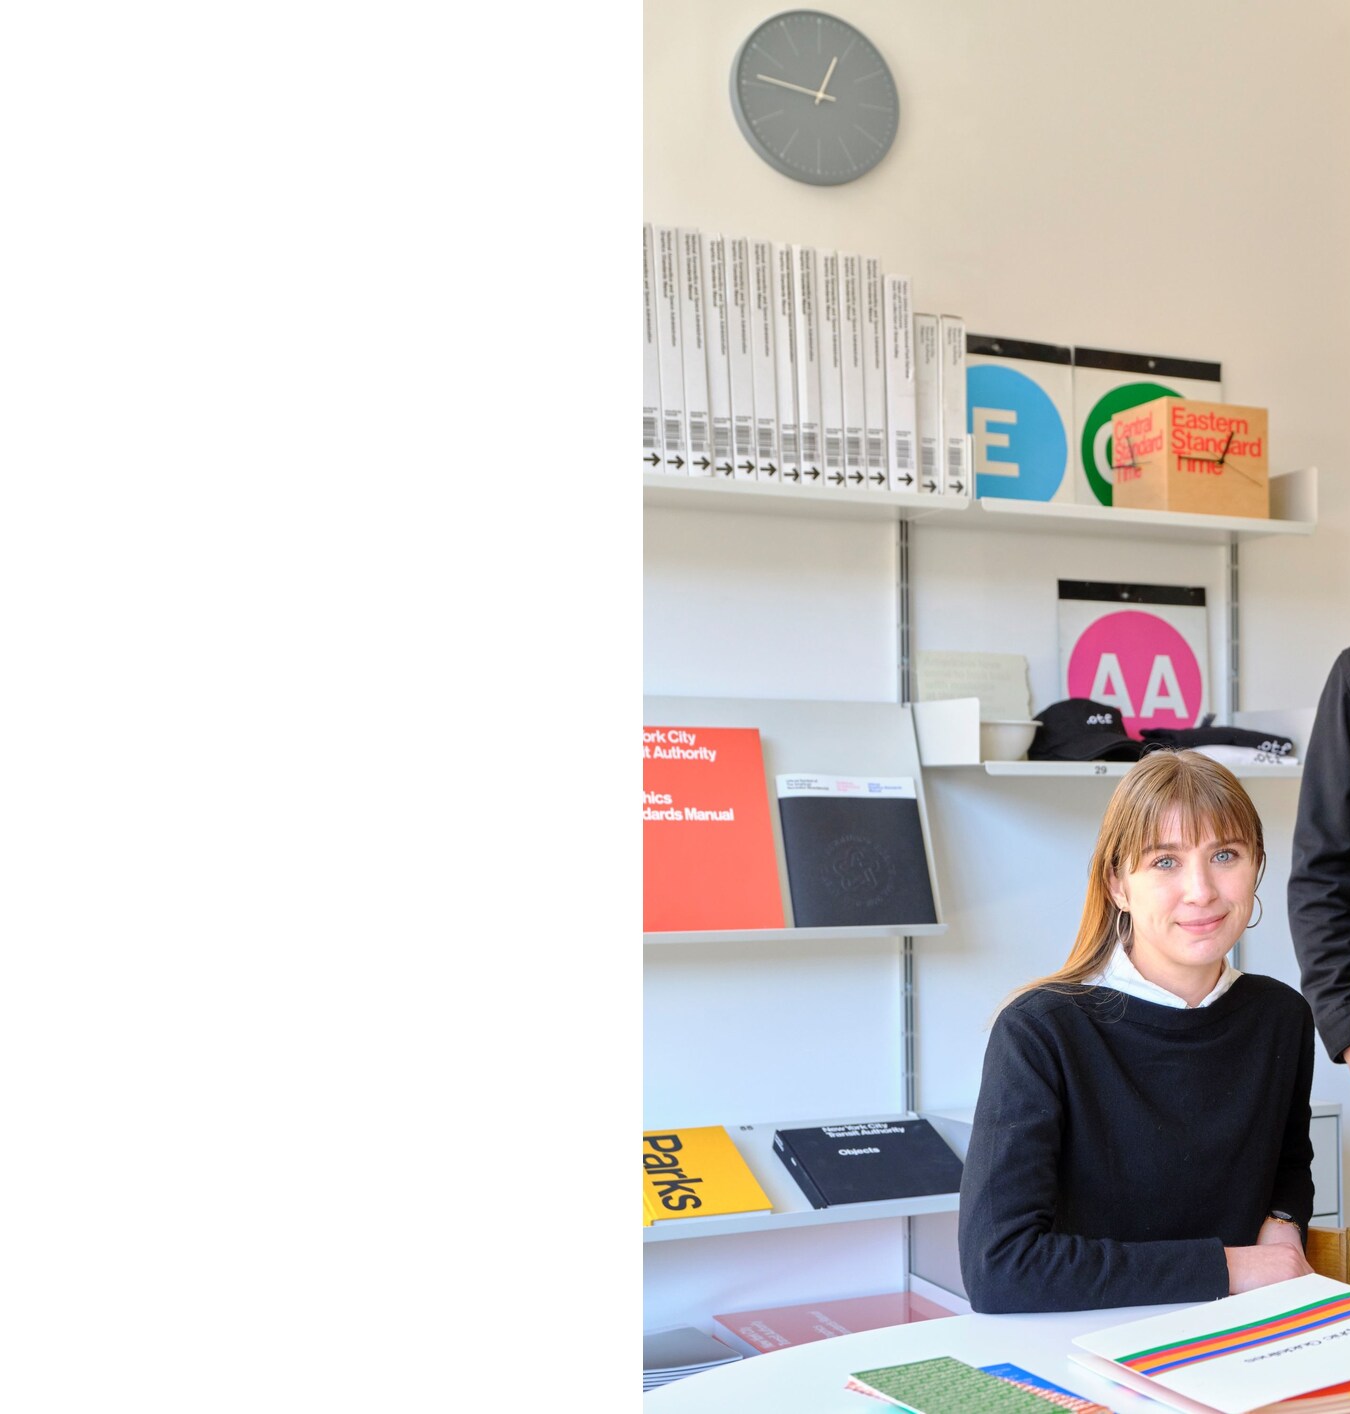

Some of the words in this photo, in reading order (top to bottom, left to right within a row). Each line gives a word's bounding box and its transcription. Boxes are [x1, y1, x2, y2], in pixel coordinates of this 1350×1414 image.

[1114, 411, 1152, 442] Central
[1172, 406, 1248, 434] Eastern
[972, 407, 1019, 478] E
[1114, 429, 1163, 462] Standard
[1171, 428, 1262, 458] Standard
[1116, 457, 1142, 484] Time
[1172, 450, 1224, 476] Time
[1089, 652, 1188, 718] AA
[643, 730, 666, 743] ork
[667, 730, 696, 746] City
[654, 746, 716, 762] Authority
[643, 791, 672, 804] hics
[643, 807, 683, 820] dards
[684, 807, 734, 821] Manual
[826, 1130, 860, 1138] Transit
[861, 1126, 905, 1136] Authority
[844, 1124, 868, 1132] York
[838, 1147, 880, 1156] Objects
[643, 1134, 704, 1211] Parks
